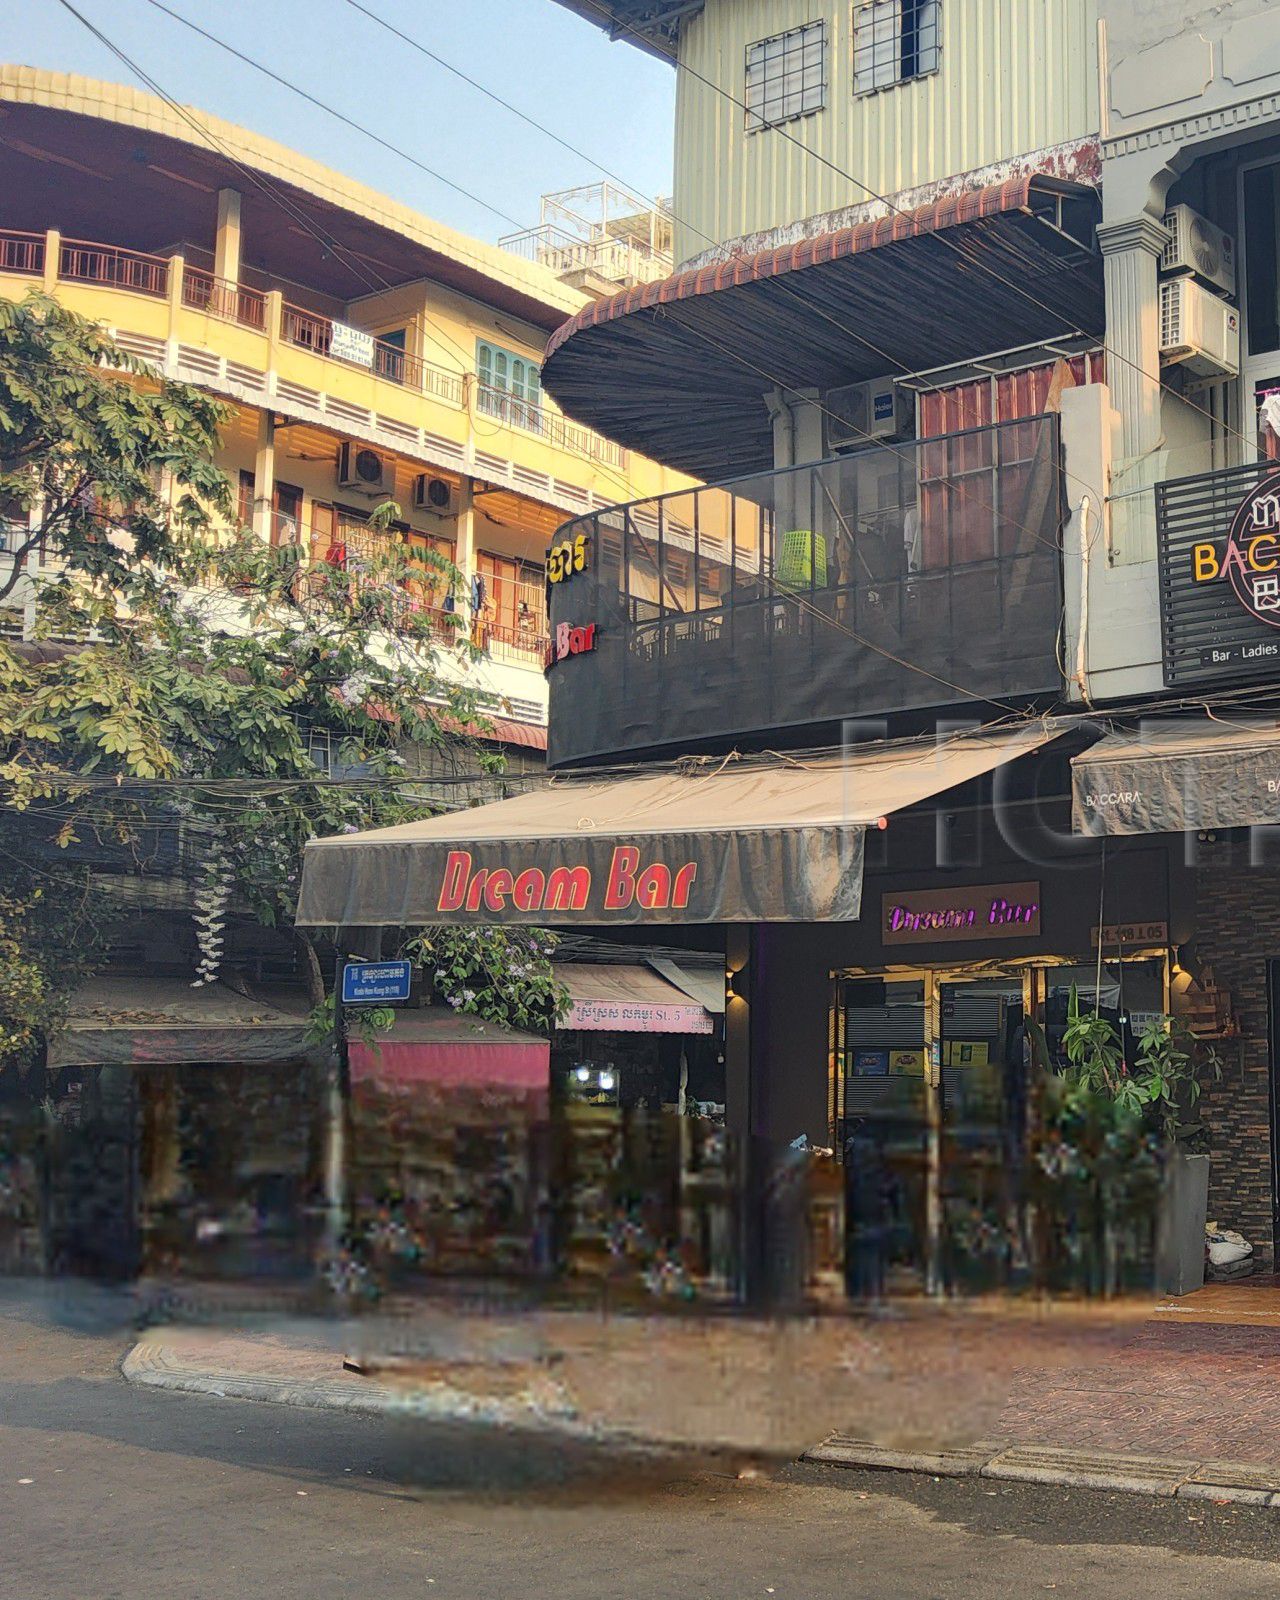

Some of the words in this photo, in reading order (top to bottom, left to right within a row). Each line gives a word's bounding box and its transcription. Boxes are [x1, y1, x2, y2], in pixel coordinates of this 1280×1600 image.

[556, 621, 596, 662] Bar
[1212, 650, 1231, 663] Bar
[1242, 645, 1278, 659] Ladies
[1085, 791, 1141, 807] BACCARA
[437, 850, 592, 912] Dream
[603, 846, 698, 910] Bar
[655, 1010, 671, 1022] St.
